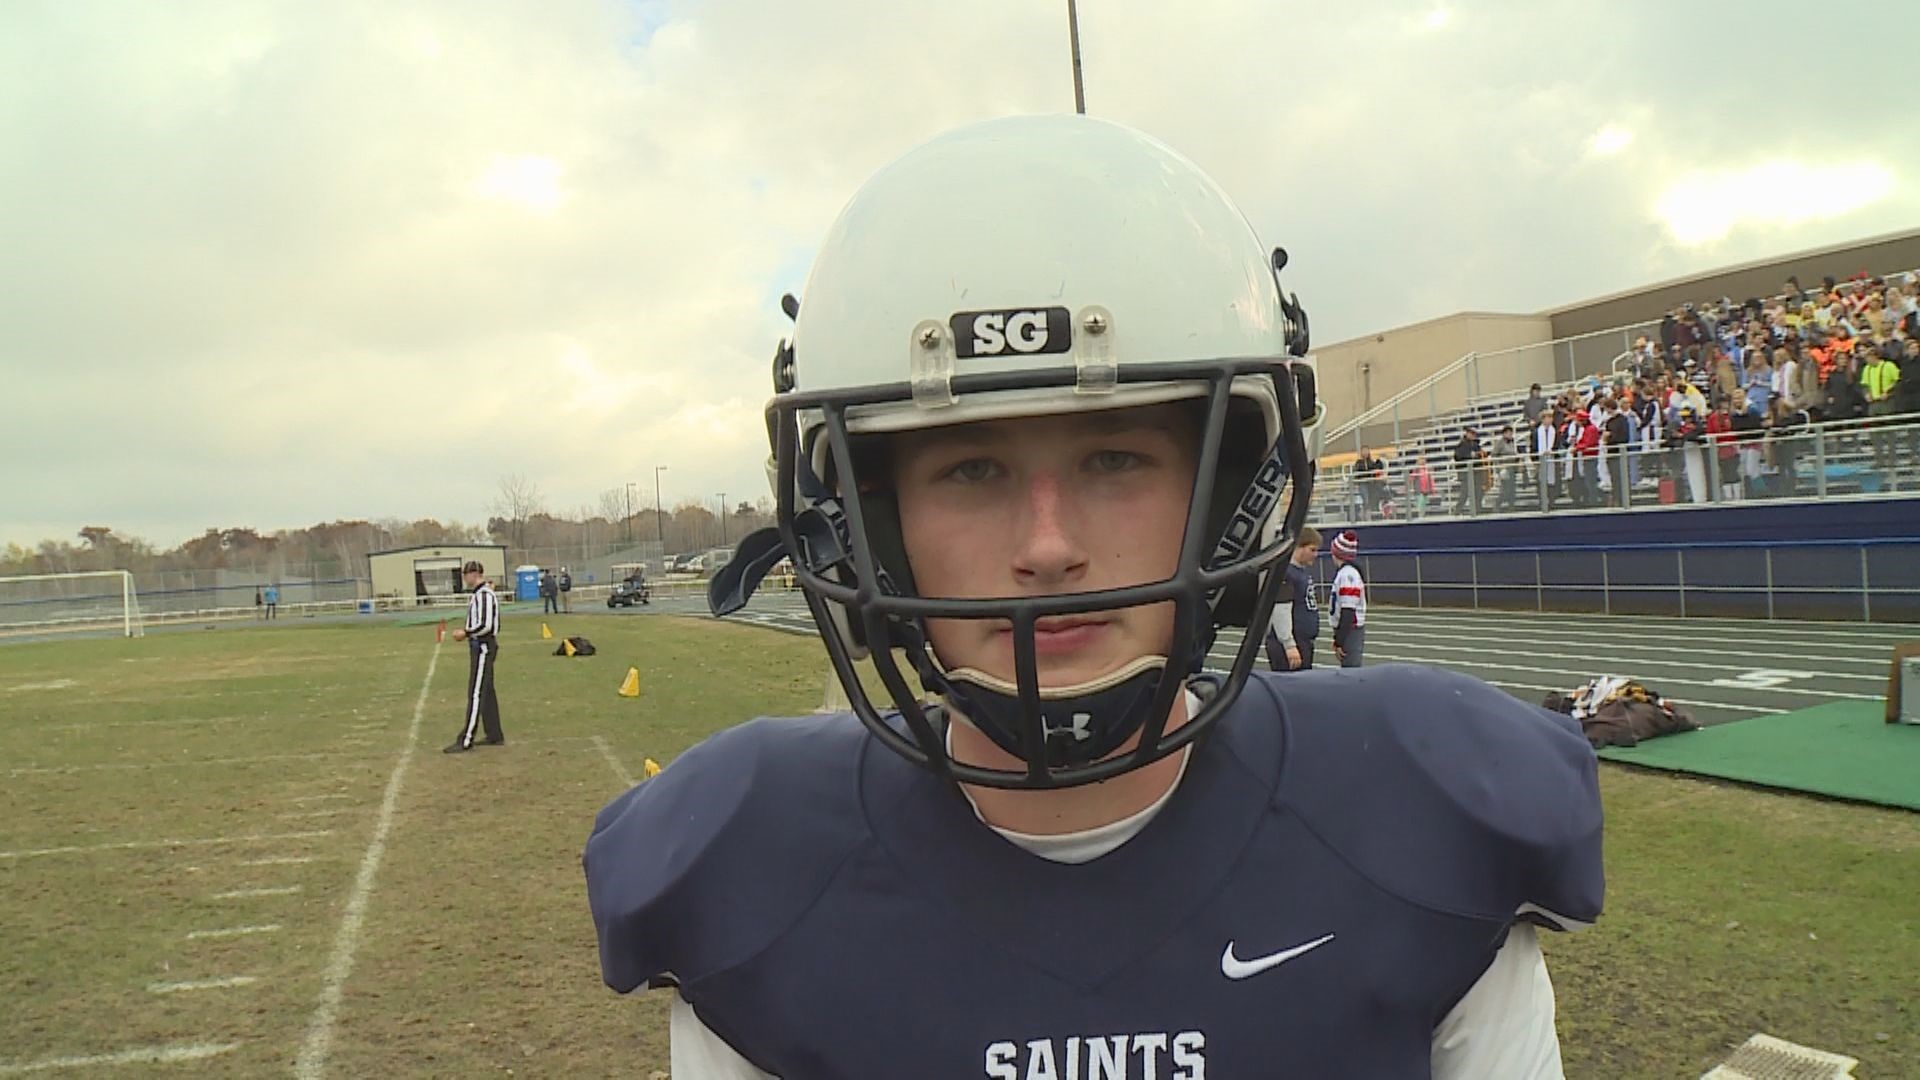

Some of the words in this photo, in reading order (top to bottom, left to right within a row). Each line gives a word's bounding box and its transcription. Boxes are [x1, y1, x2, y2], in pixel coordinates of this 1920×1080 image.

[973, 311, 1048, 355] SG
[1210, 459, 1284, 570] NDER
[985, 1031, 1206, 1080] SAINTS
